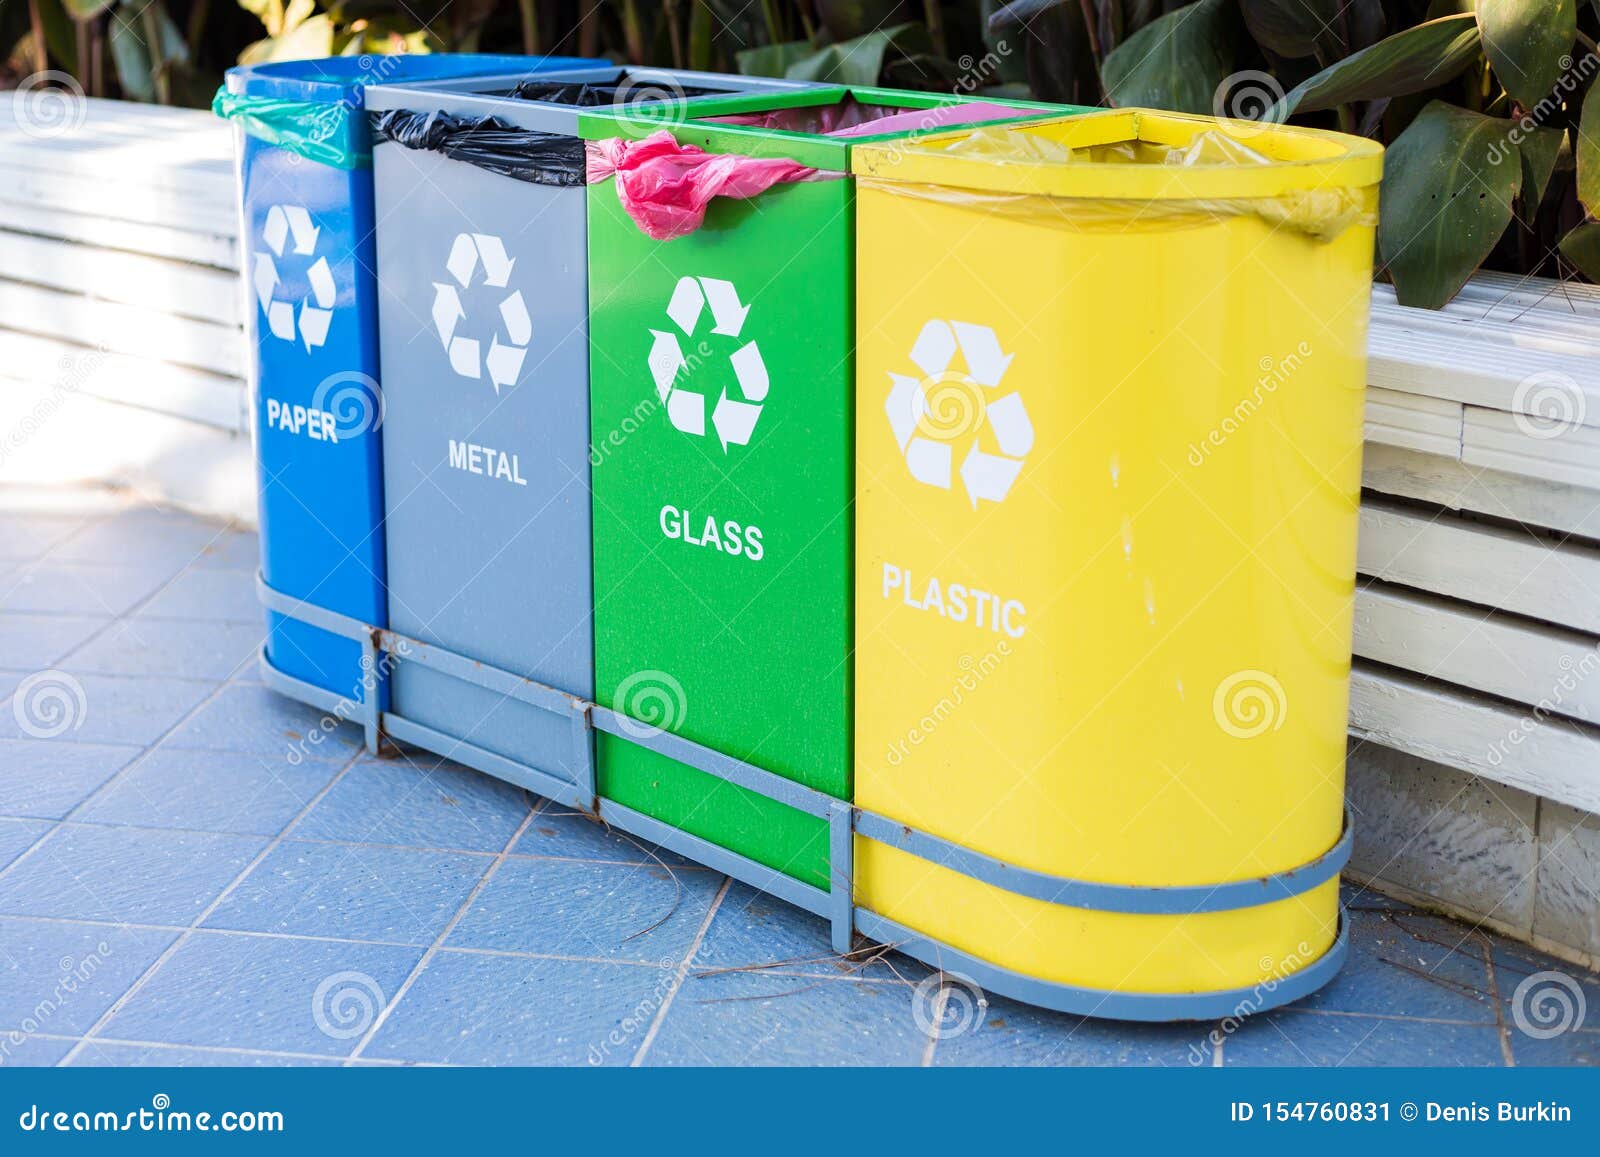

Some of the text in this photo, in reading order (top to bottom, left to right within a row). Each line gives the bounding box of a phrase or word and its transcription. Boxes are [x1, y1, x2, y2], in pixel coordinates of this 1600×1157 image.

[266, 398, 338, 443] PAPER
[448, 439, 527, 485] METAL
[660, 505, 764, 560] GLASS
[883, 563, 1025, 638] PLASTIC
